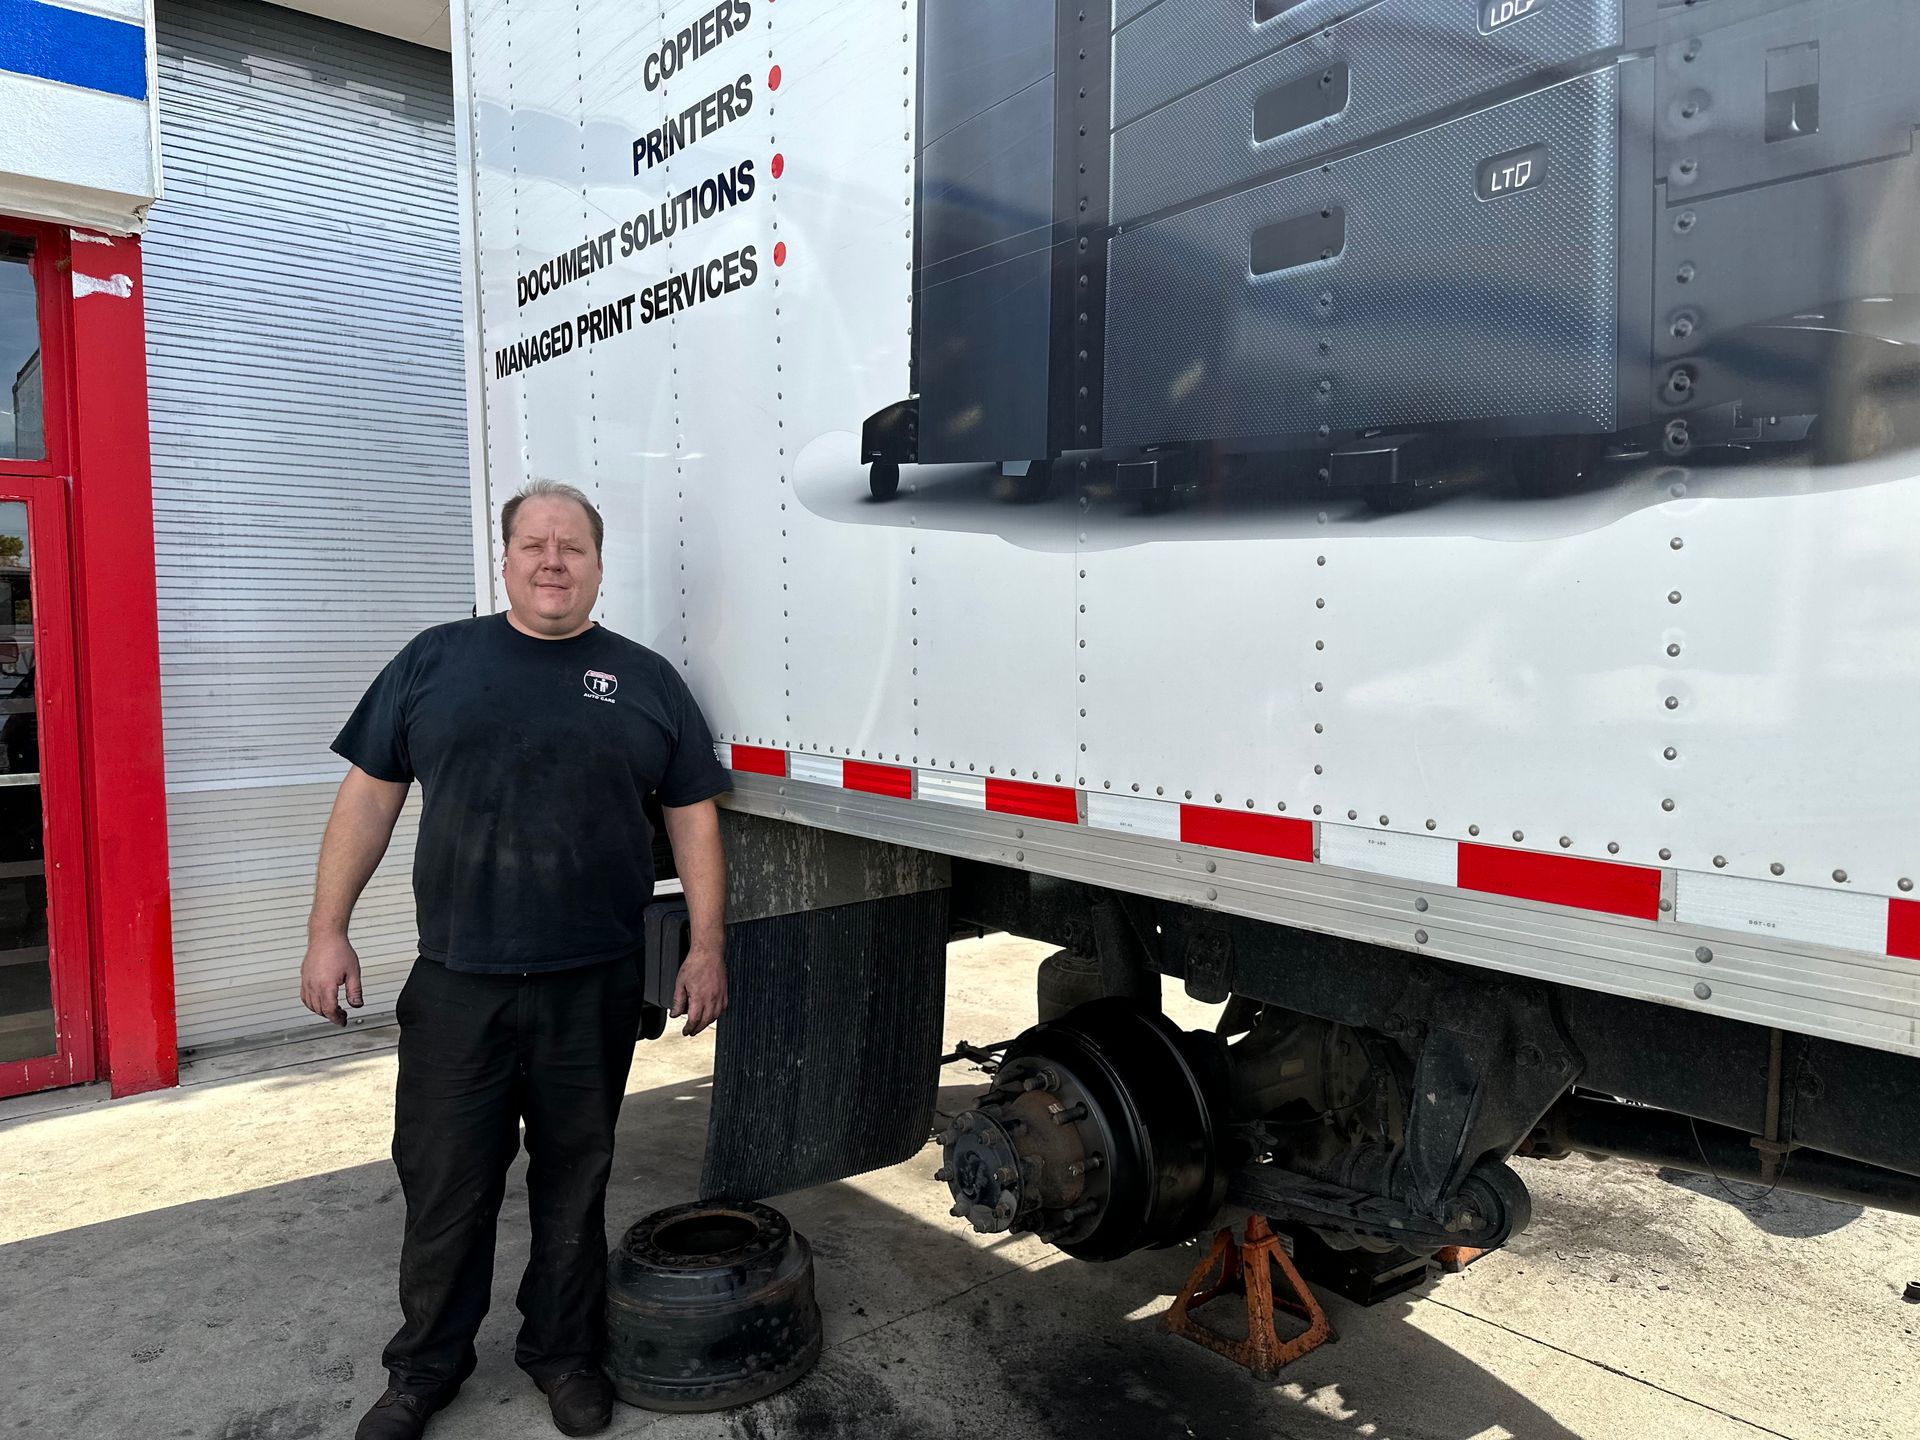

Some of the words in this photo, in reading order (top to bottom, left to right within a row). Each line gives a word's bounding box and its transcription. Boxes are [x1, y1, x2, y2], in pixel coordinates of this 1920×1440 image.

[643, 0, 752, 92] COPIERS
[632, 73, 753, 177] PRINTERS
[516, 228, 616, 308] DOCUMENT
[620, 159, 756, 258] SOLUTIONS
[495, 320, 573, 380] MANAGED
[576, 293, 636, 349] PRINT
[640, 244, 758, 325] SERVICES
